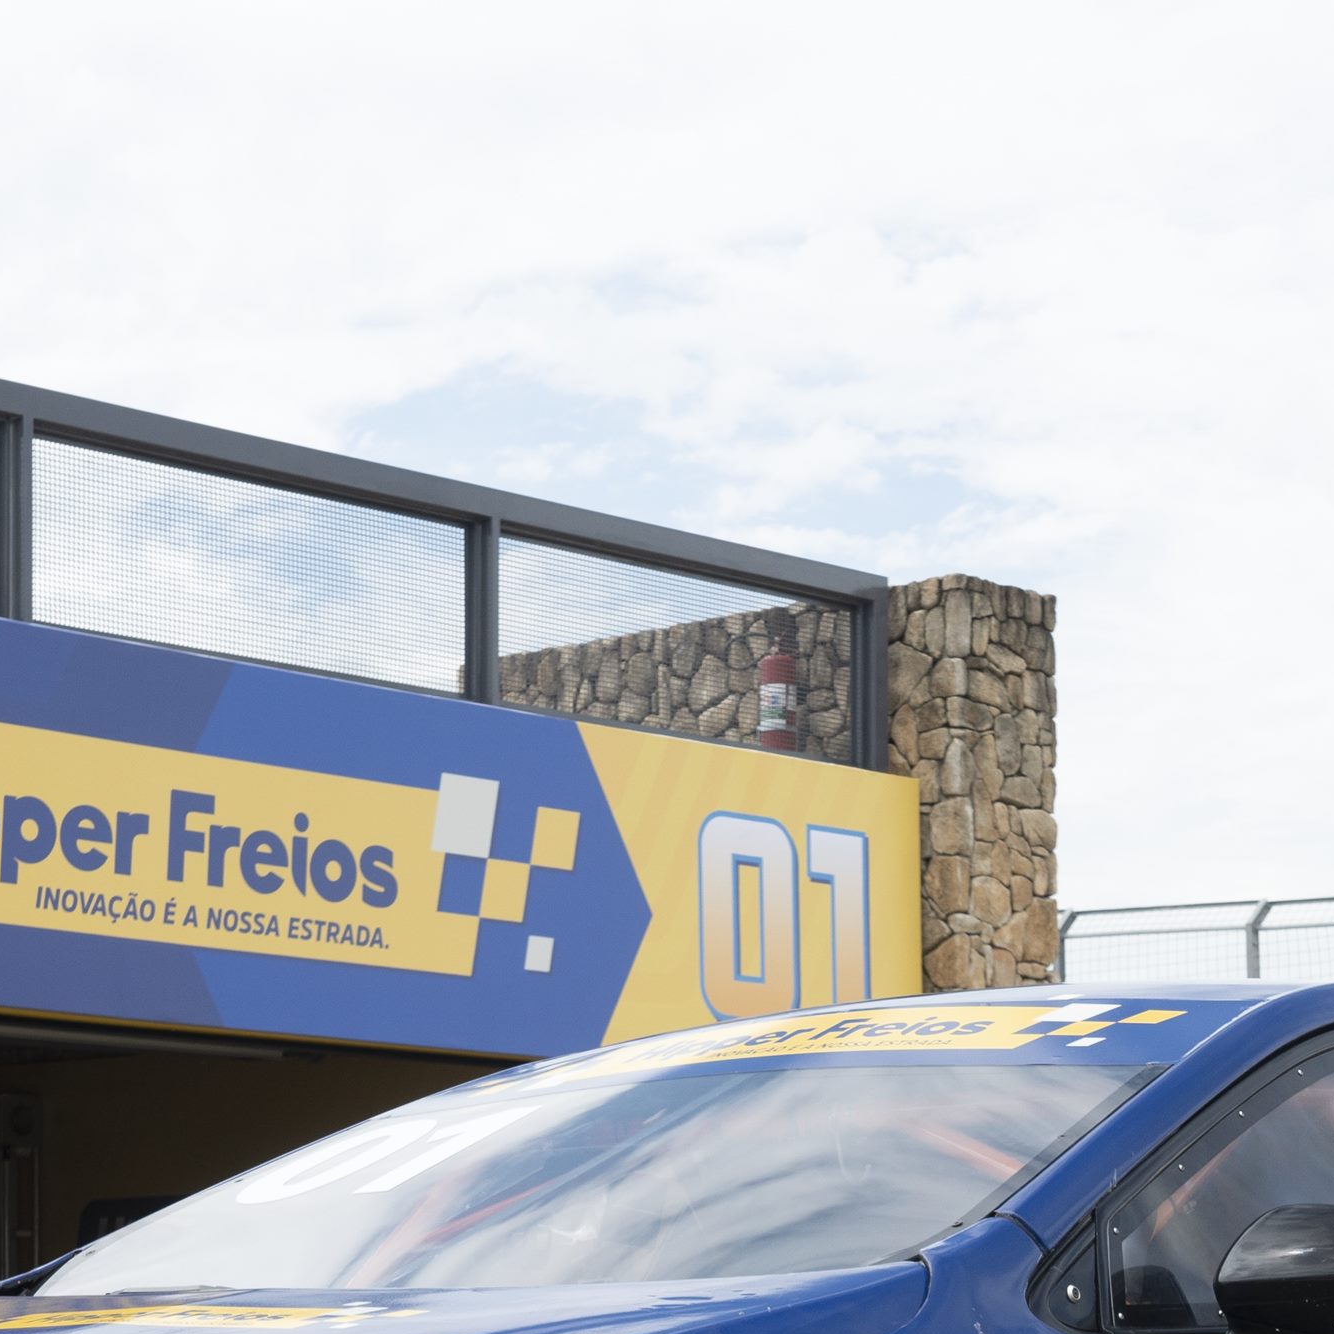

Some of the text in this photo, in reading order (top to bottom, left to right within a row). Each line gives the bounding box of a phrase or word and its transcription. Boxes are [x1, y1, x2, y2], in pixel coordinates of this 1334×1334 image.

[167, 790, 398, 908] Freios
[36, 886, 389, 948] INOVAÇÃO É A NOSSA ESTRADA.
[698, 810, 871, 1021] 01
[808, 1016, 995, 1041] Freios
[235, 1105, 543, 1204] 01
